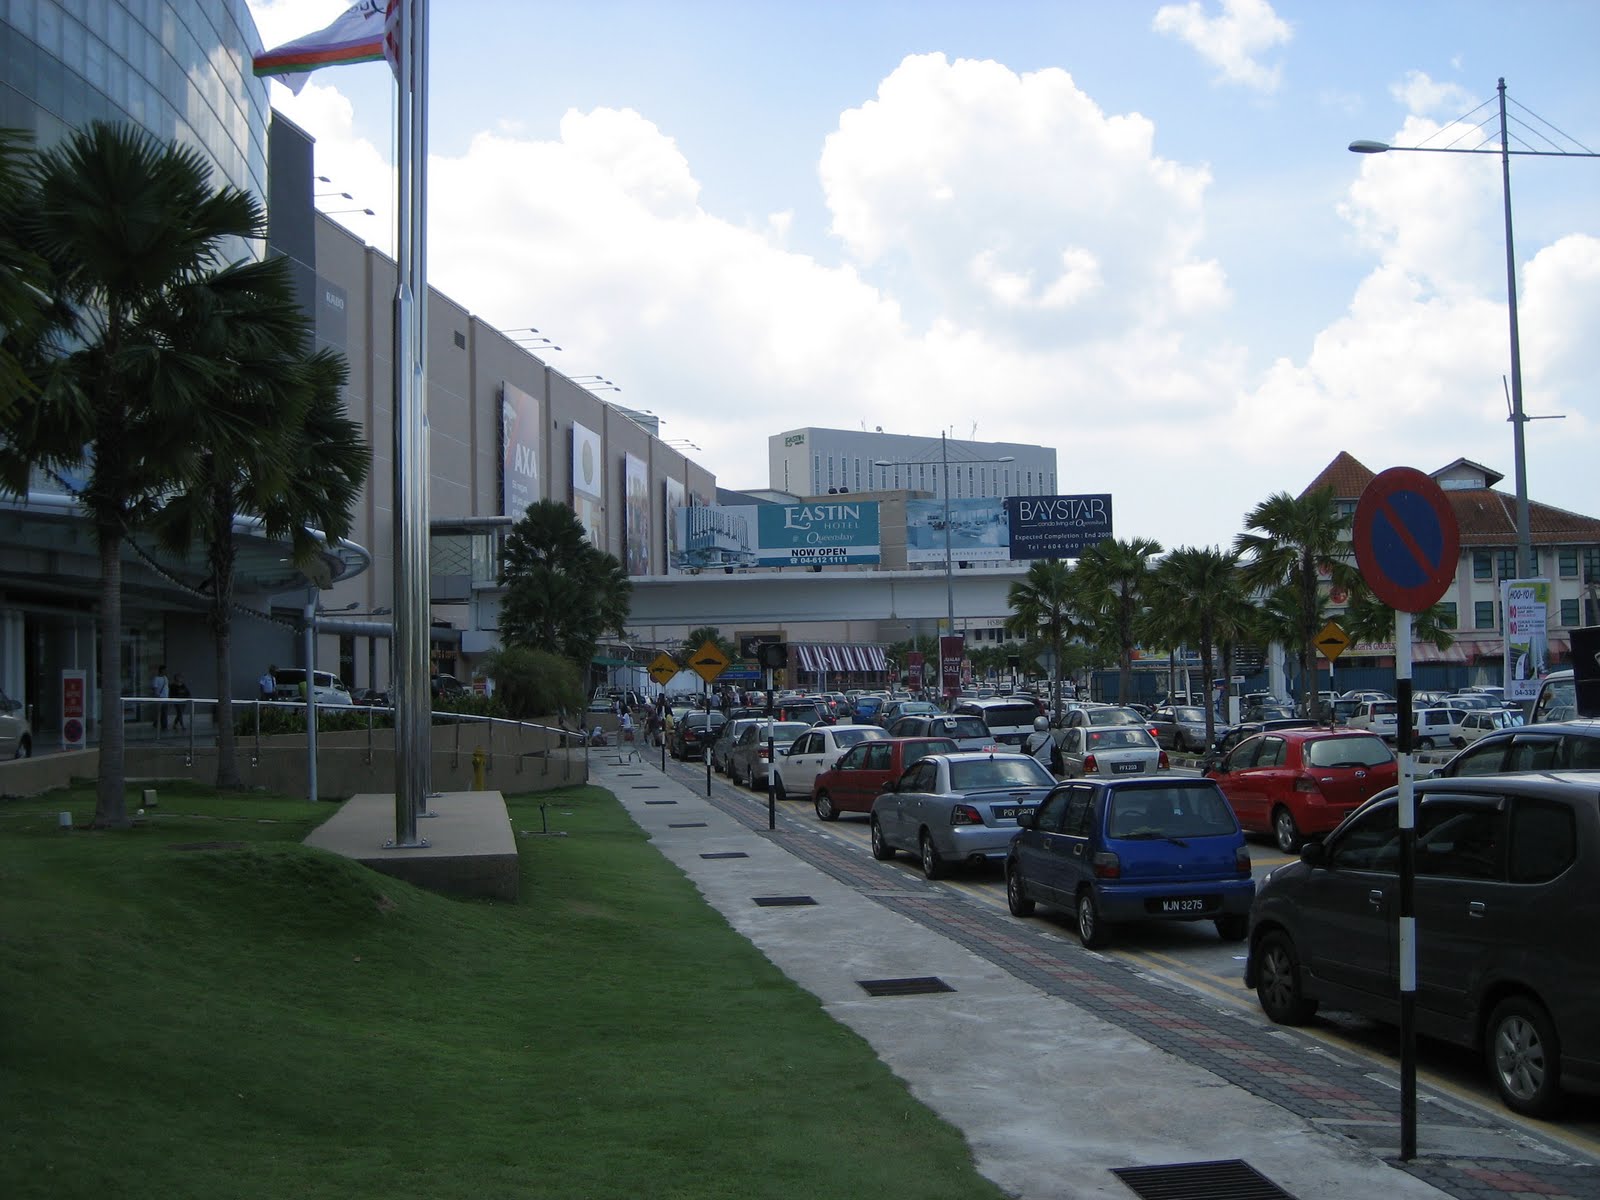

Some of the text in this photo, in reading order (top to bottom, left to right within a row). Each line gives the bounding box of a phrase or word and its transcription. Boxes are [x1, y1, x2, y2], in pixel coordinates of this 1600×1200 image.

[514, 443, 537, 480] AXA
[784, 504, 860, 530] EASTIN
[1020, 499, 1108, 525] BAYSTAR
[806, 531, 854, 544] Queensbay
[1014, 533, 1043, 541] Expected
[1044, 532, 1079, 540] Completion
[791, 547, 847, 557] NOW OPEN
[1509, 605, 1517, 618] NO
[1509, 621, 1517, 635] NO
[1162, 899, 1203, 911] WJN 3275
